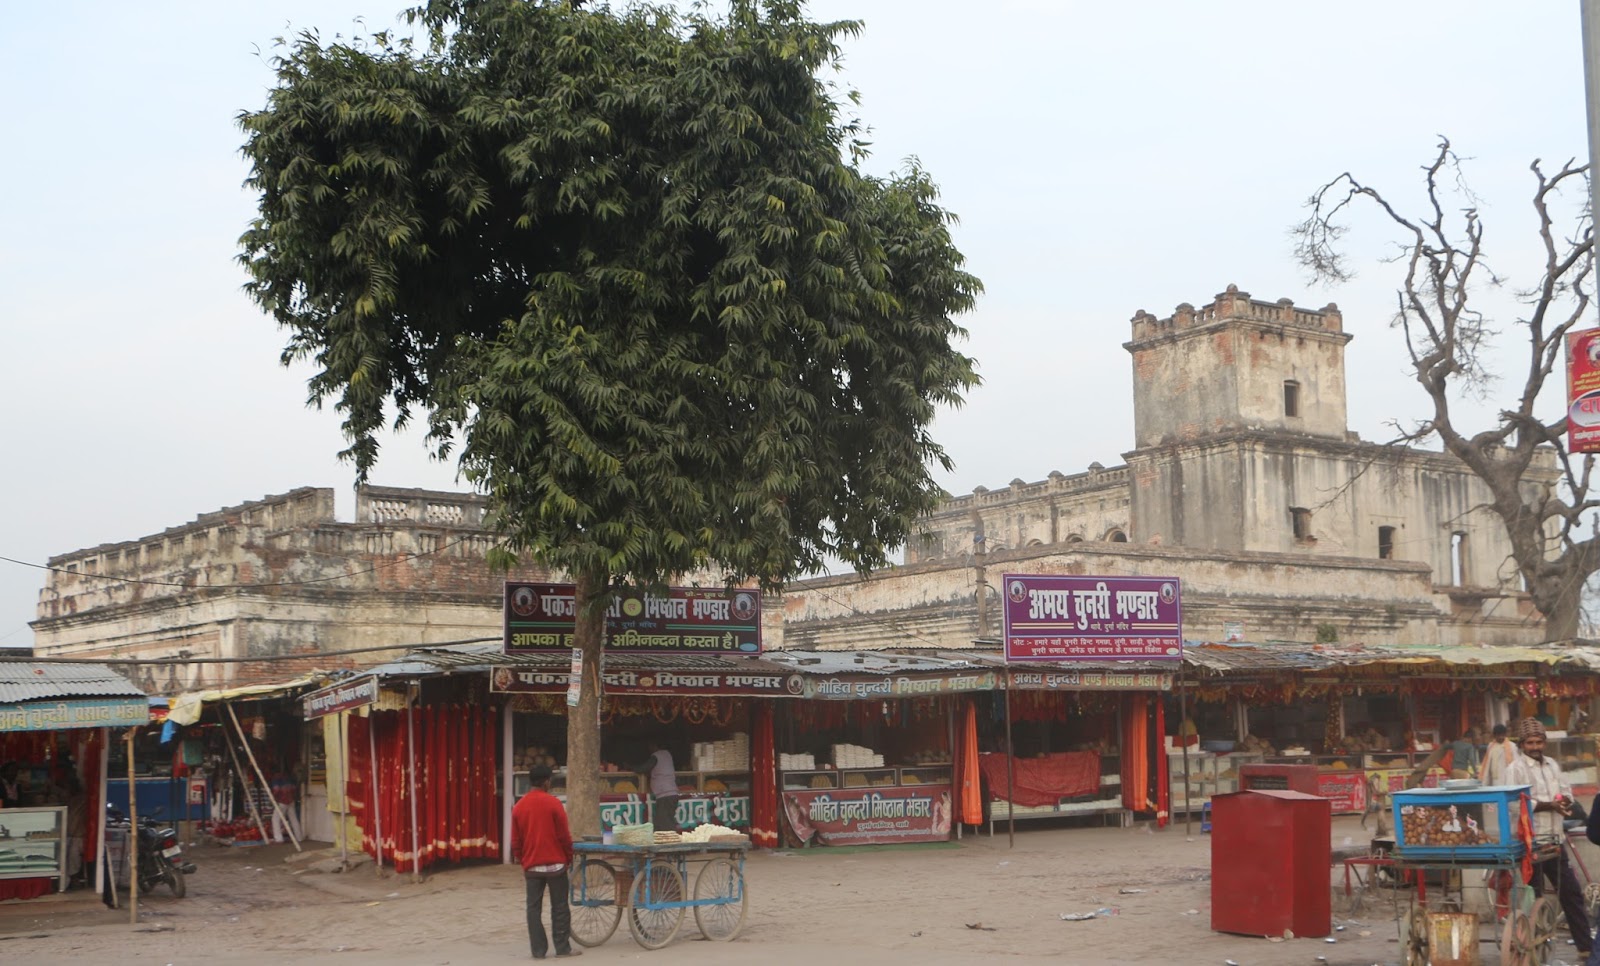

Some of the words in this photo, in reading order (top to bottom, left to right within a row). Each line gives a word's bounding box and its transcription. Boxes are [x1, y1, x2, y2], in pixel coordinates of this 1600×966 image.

[692, 598, 735, 621] भण्डार
[1028, 589, 1069, 619] अभय
[1073, 582, 1112, 631] चुनरी
[1116, 590, 1159, 620] भण्डार
[511, 633, 560, 646] आपका
[611, 629, 680, 647] अभिनन्दन
[683, 635, 719, 648] करता
[1034, 638, 1048, 646] हमारे
[602, 671, 638, 687] न्दरी
[655, 672, 720, 688] मिष्ठान
[725, 675, 782, 688] भण्डार
[817, 678, 852, 694] मोहित
[854, 678, 893, 697] चुन्दरी
[600, 793, 643, 826] न्दरी
[809, 794, 838, 821] मोहित
[840, 793, 870, 826] चुन्दरी
[872, 792, 905, 819] मिष्ठान
[907, 792, 931, 818] भंडार
